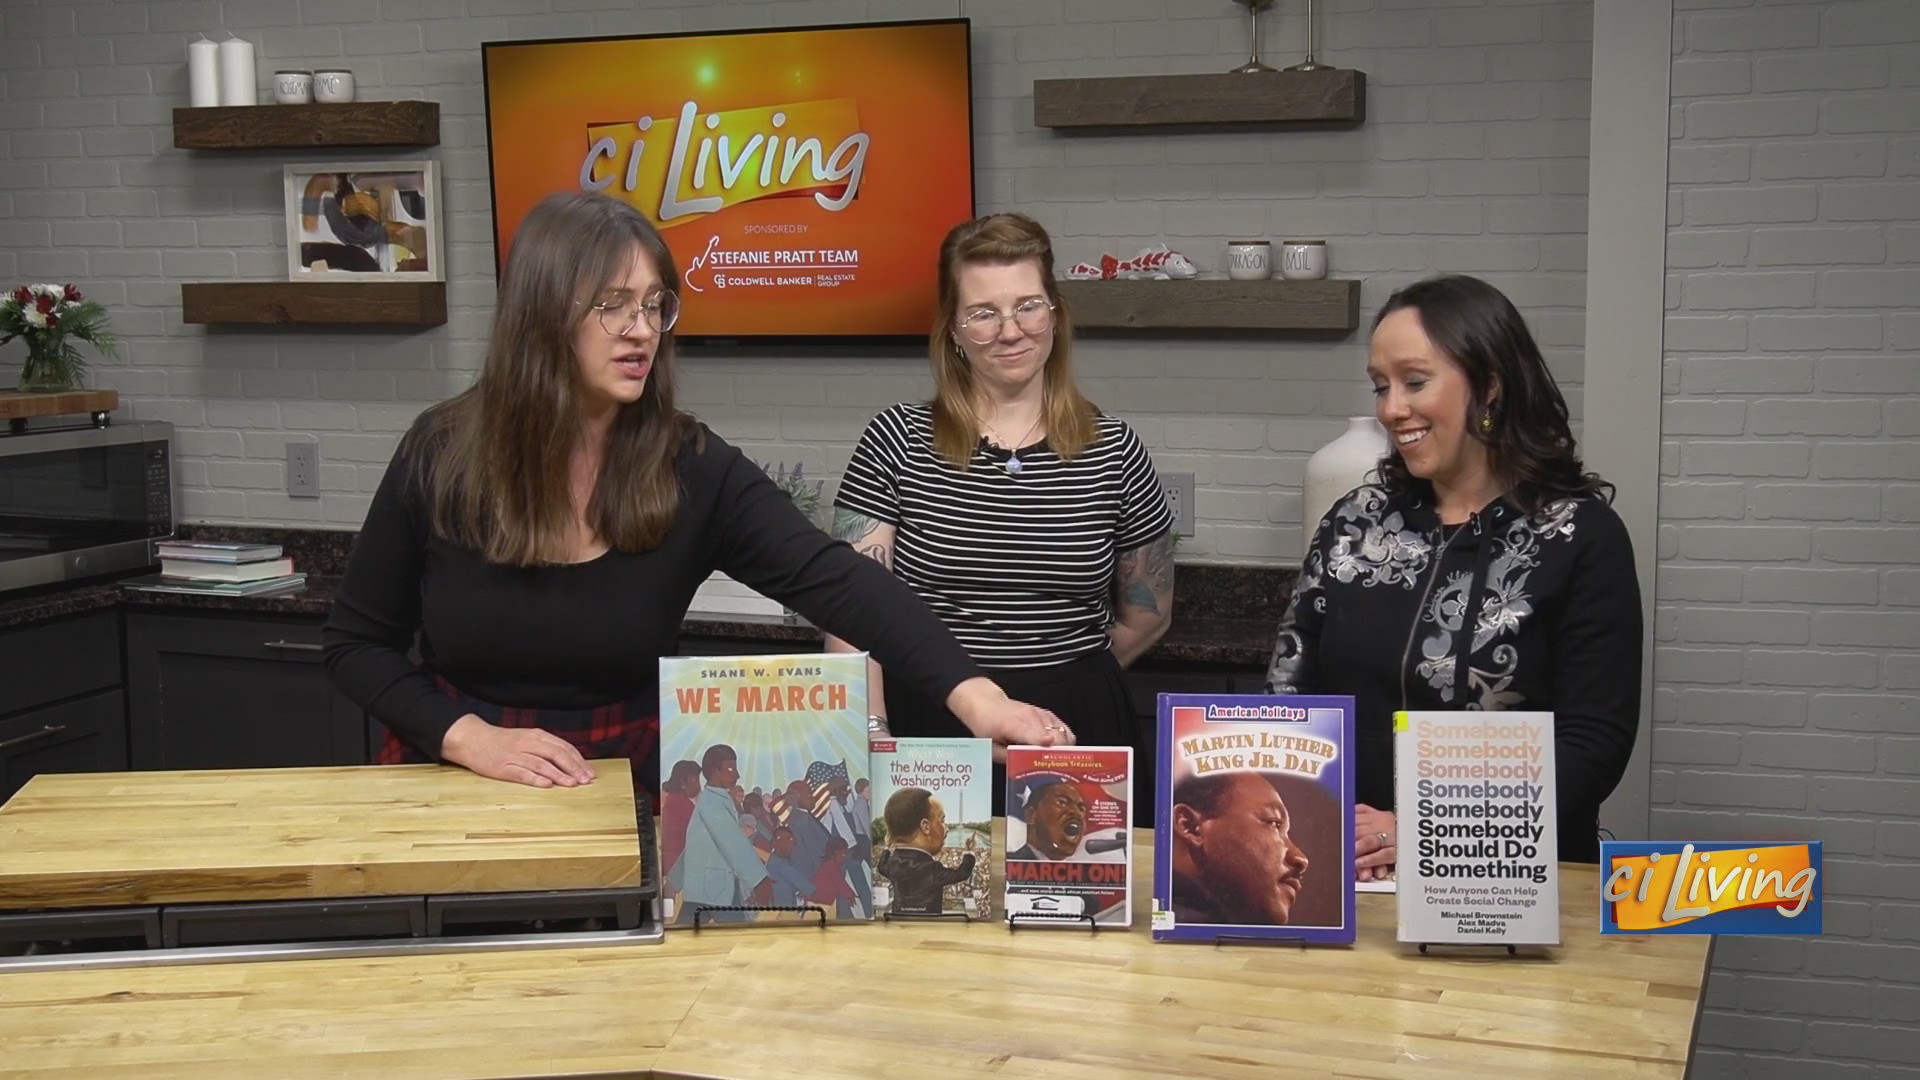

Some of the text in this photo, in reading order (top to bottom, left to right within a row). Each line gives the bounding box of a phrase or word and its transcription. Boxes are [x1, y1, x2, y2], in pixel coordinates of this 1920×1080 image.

[580, 101, 869, 221] ci Living
[744, 225, 808, 234] SPONSORED BY
[710, 250, 858, 264] STEFANIE PRATT TEAM
[1285, 251, 1312, 271] BASIL
[728, 277, 812, 286] COLDWELL BANKER
[701, 667, 822, 678] SHANE W. EVANS
[676, 684, 848, 714] WE MARCH
[1209, 705, 1305, 720] American Holidays
[1417, 720, 1542, 742] Somebody
[1181, 732, 1334, 759] MARTIN LUTHER
[1417, 740, 1542, 763] Somebody
[890, 760, 972, 773] the March on
[1033, 760, 1102, 768] Storybook Treasures
[1194, 752, 1321, 775] KING JR. DAY
[1417, 760, 1542, 782] Somebody
[890, 774, 971, 790] Washington?
[1417, 779, 1543, 803] Somebody
[1417, 799, 1543, 822] Somebody
[1417, 819, 1543, 842] Somebody
[1418, 839, 1537, 858] Should Do
[1007, 862, 1125, 882] MARCH ON!
[1418, 859, 1547, 883] Something
[1424, 885, 1538, 896] How Anyone Can Help
[1426, 896, 1536, 907] Create Social Change
[1441, 911, 1473, 919] Michael
[1478, 919, 1506, 927] Madva
[1485, 927, 1506, 935] Kelly
